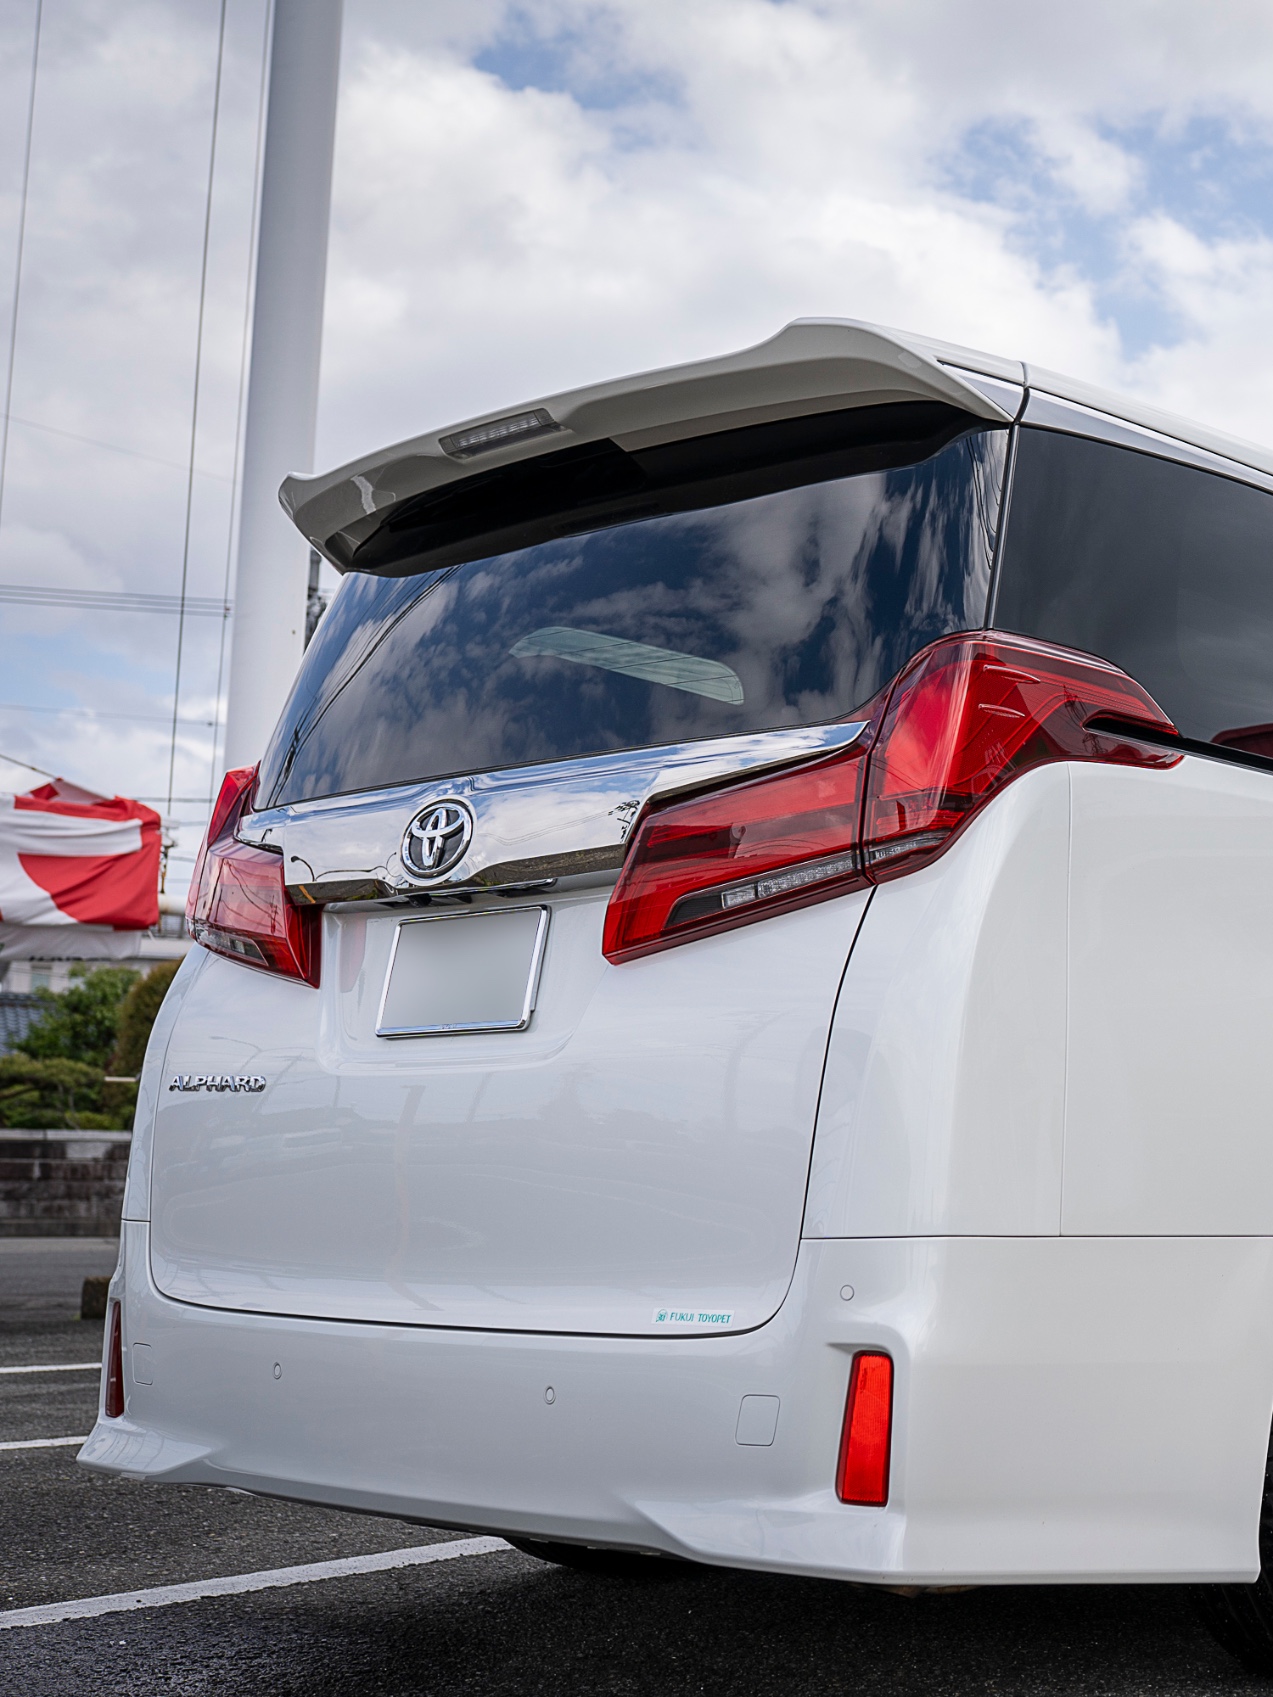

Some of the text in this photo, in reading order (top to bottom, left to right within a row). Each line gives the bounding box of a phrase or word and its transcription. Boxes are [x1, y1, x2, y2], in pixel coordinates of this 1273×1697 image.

[169, 1075, 266, 1092] ALPHARD
[669, 1312, 732, 1324] FUKUI TOYOPET
